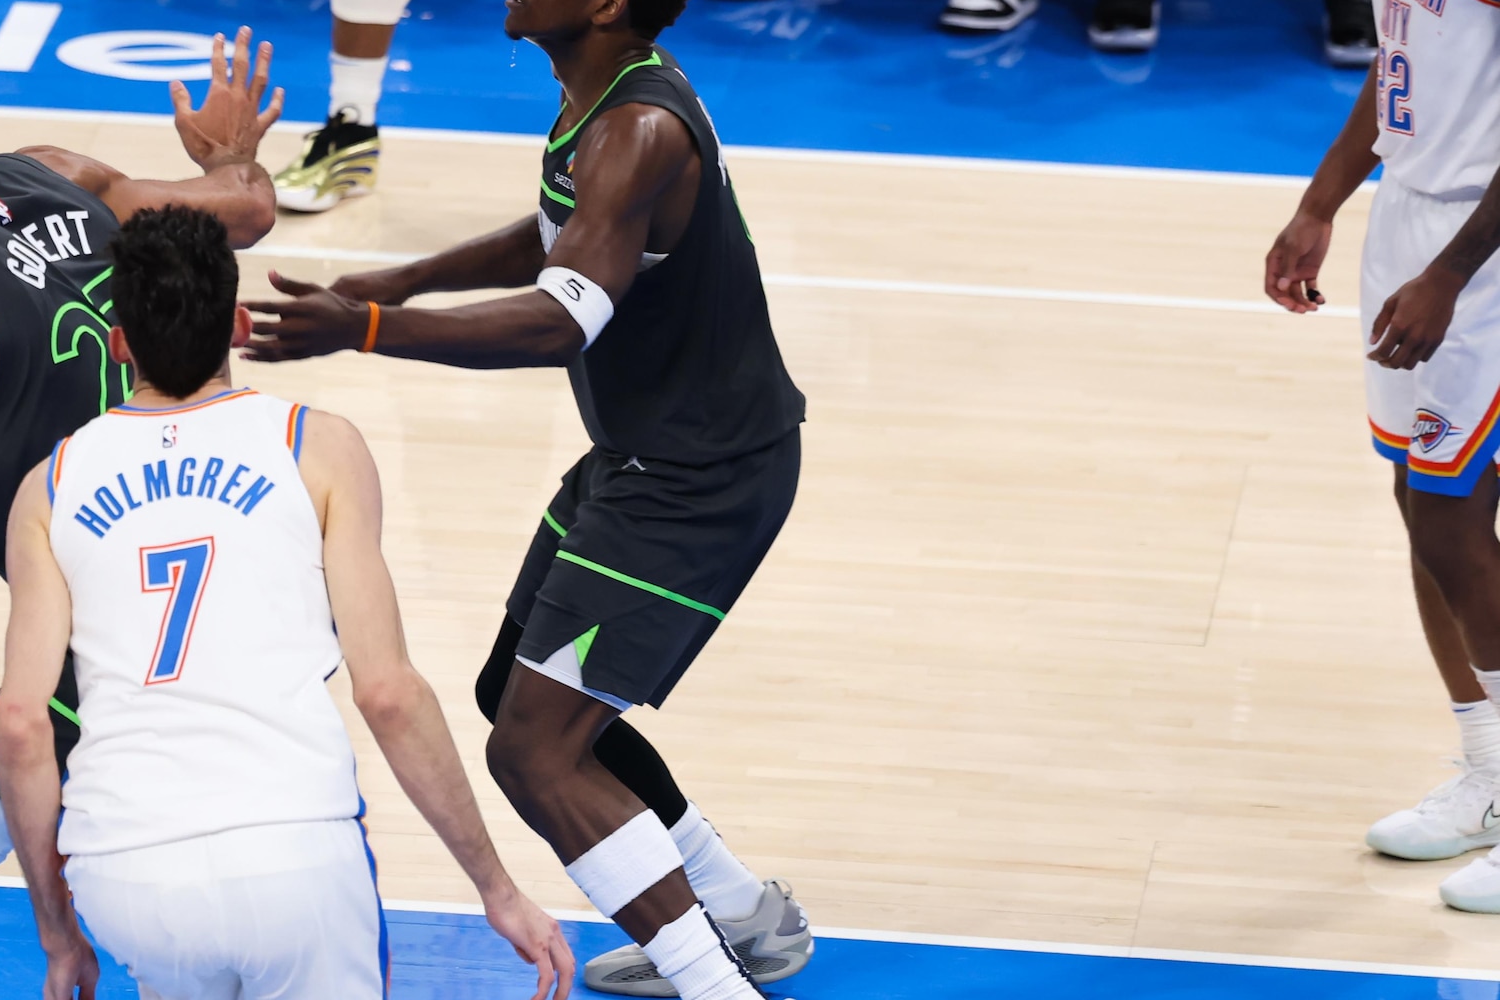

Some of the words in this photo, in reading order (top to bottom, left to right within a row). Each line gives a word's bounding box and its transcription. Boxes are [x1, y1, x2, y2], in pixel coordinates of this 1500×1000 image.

[559, 278, 586, 302] 5
[74, 457, 275, 539] HOLMGREN
[139, 536, 215, 686] 7
